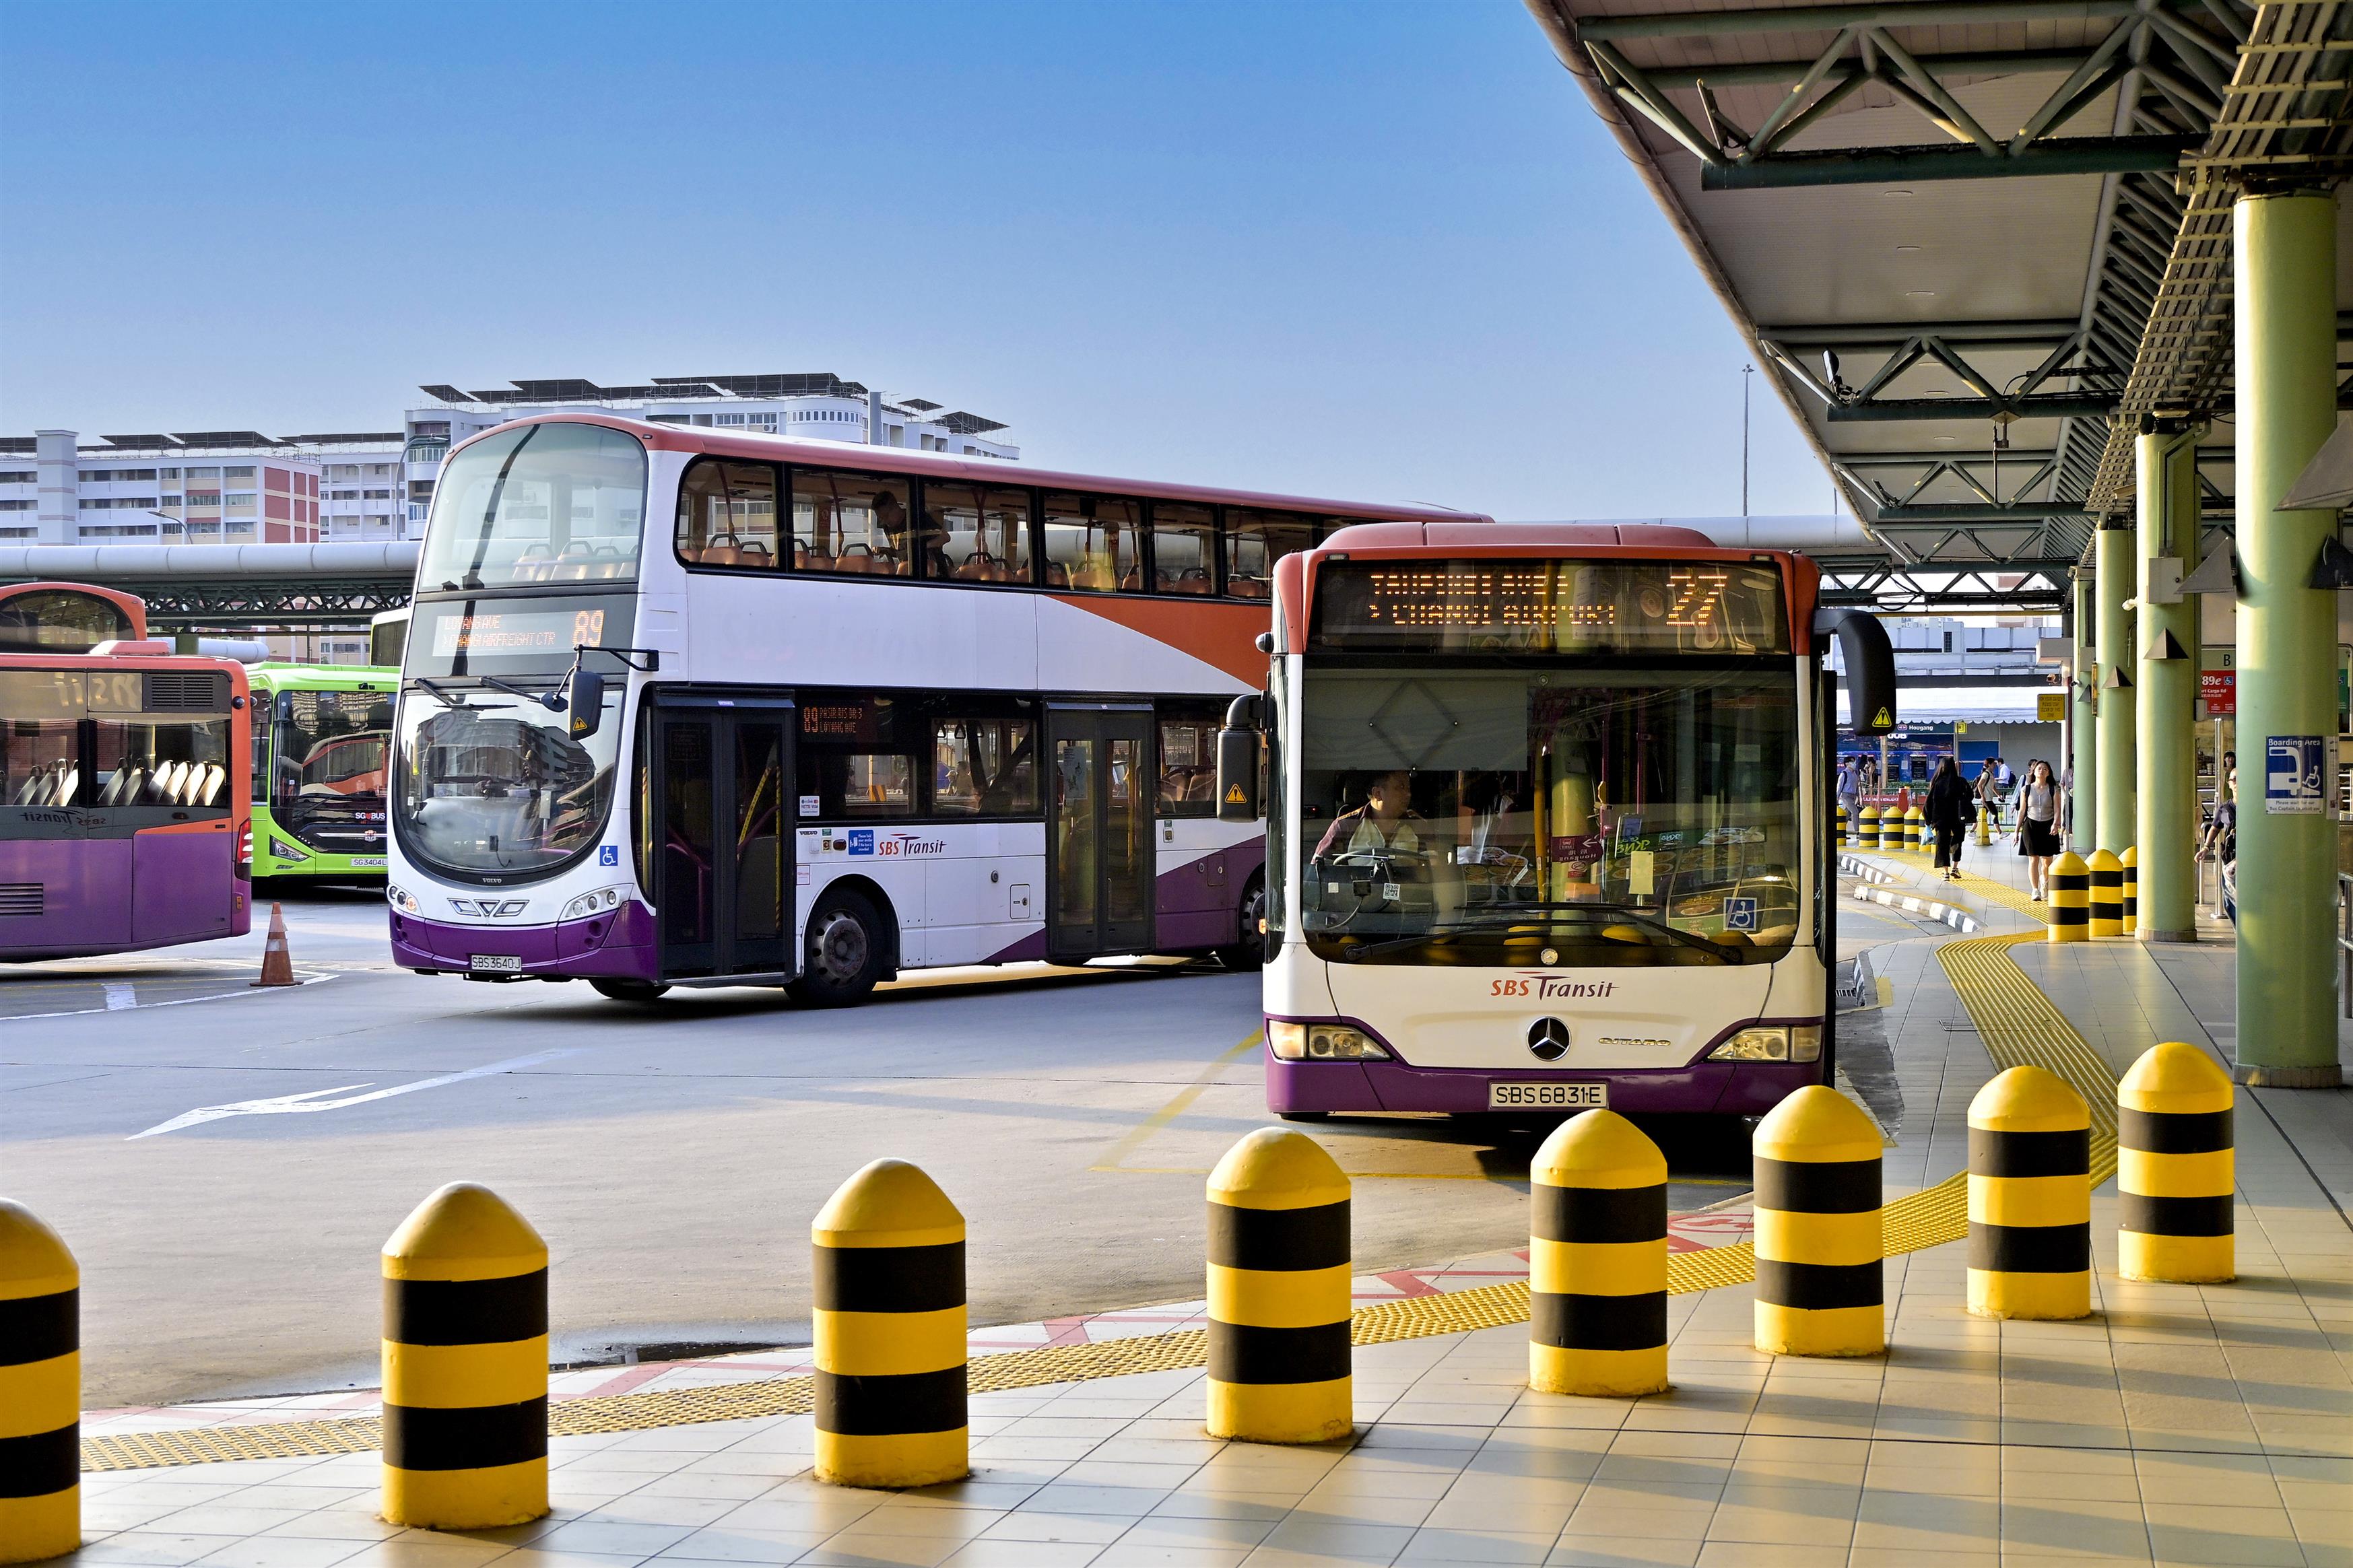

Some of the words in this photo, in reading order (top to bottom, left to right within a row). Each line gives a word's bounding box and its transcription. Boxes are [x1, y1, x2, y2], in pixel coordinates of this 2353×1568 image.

[1666, 575, 1727, 625] 27
[482, 615, 502, 629] AVE
[572, 610, 605, 648] 89
[2223, 654, 2231, 667] B
[803, 707, 818, 732] 89
[2268, 739, 2302, 747] Boarding
[879, 841, 899, 856] SBS
[898, 836, 948, 858] Transit
[472, 957, 521, 969] SBS3640J
[1490, 980, 1530, 996] SBS
[1528, 976, 1621, 1001] Transit
[1598, 1037, 1671, 1047] CITARO
[1496, 1086, 1601, 1104] SBS6831E
